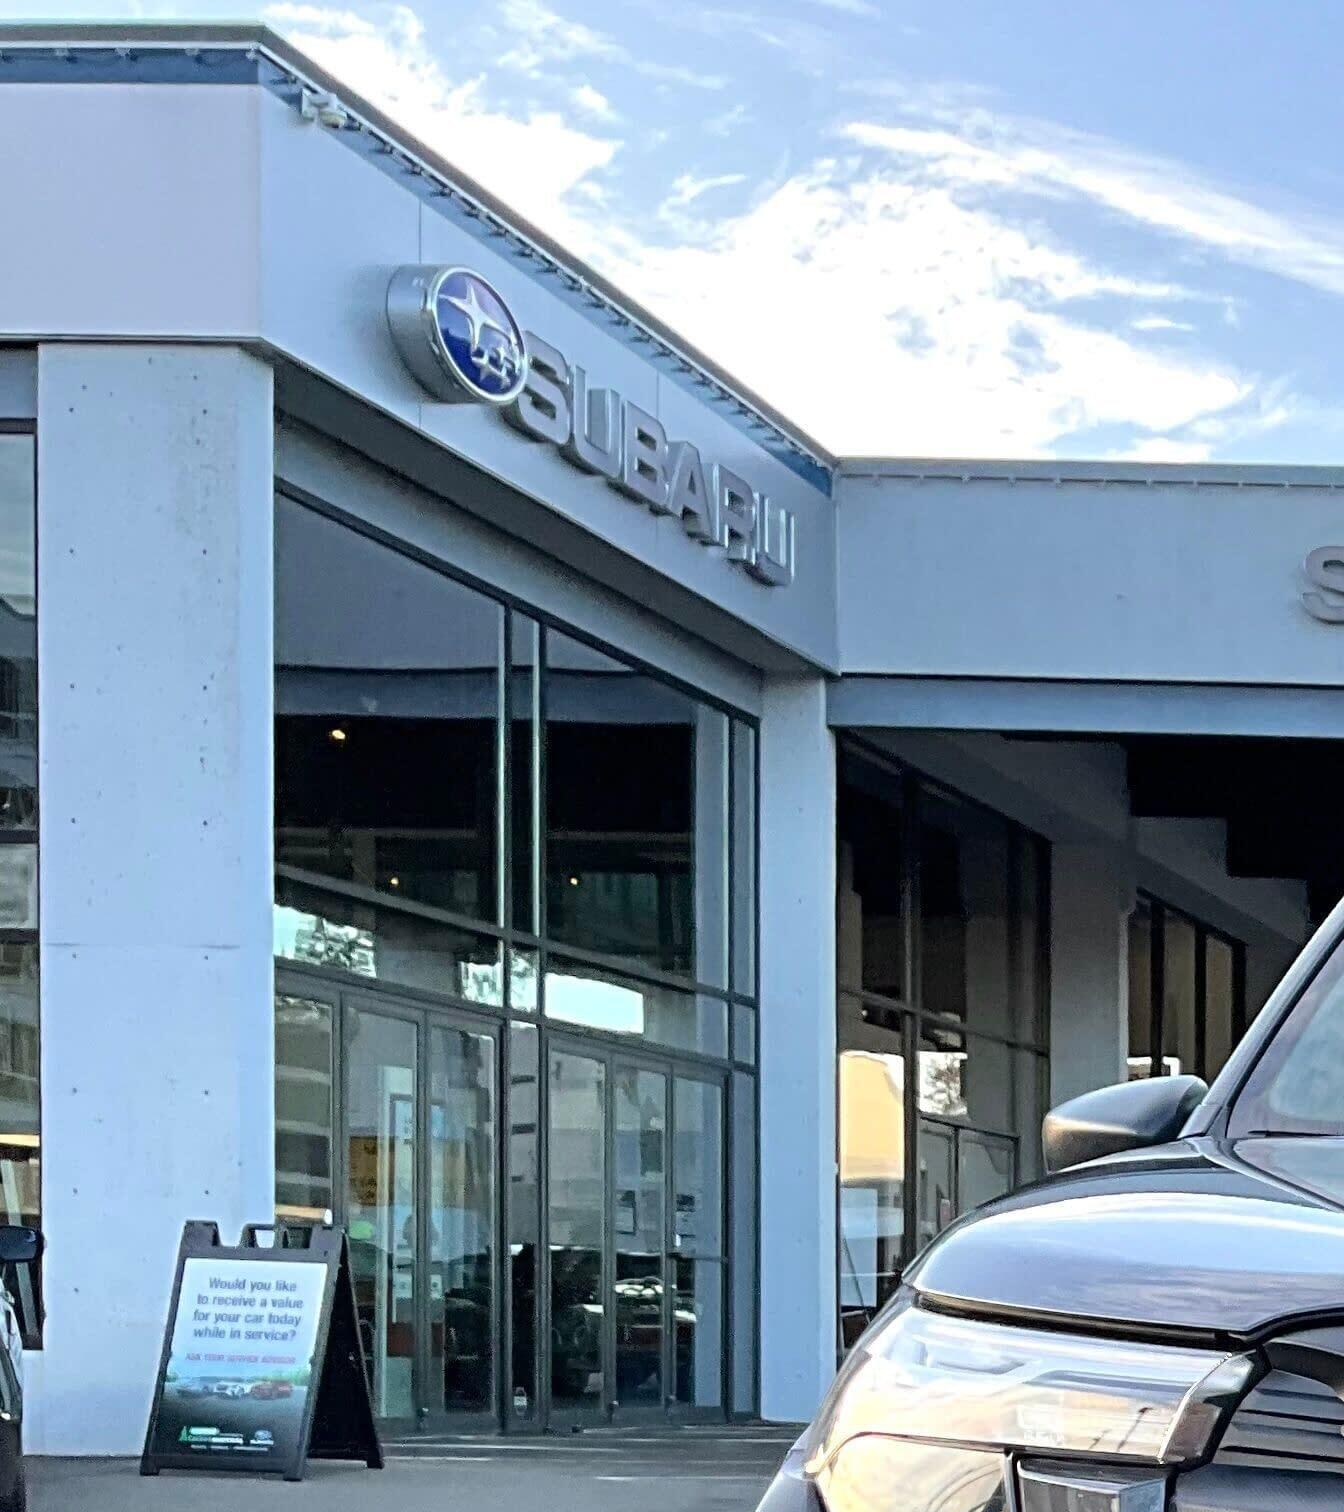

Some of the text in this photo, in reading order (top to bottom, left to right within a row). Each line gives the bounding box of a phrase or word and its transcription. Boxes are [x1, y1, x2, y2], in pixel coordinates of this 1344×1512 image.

[510, 330, 795, 586] SUBARU
[209, 1277, 297, 1292] Would you like
[197, 1293, 304, 1309] to receive a value
[193, 1309, 301, 1327] for your car today
[193, 1326, 297, 1341] while in service?
